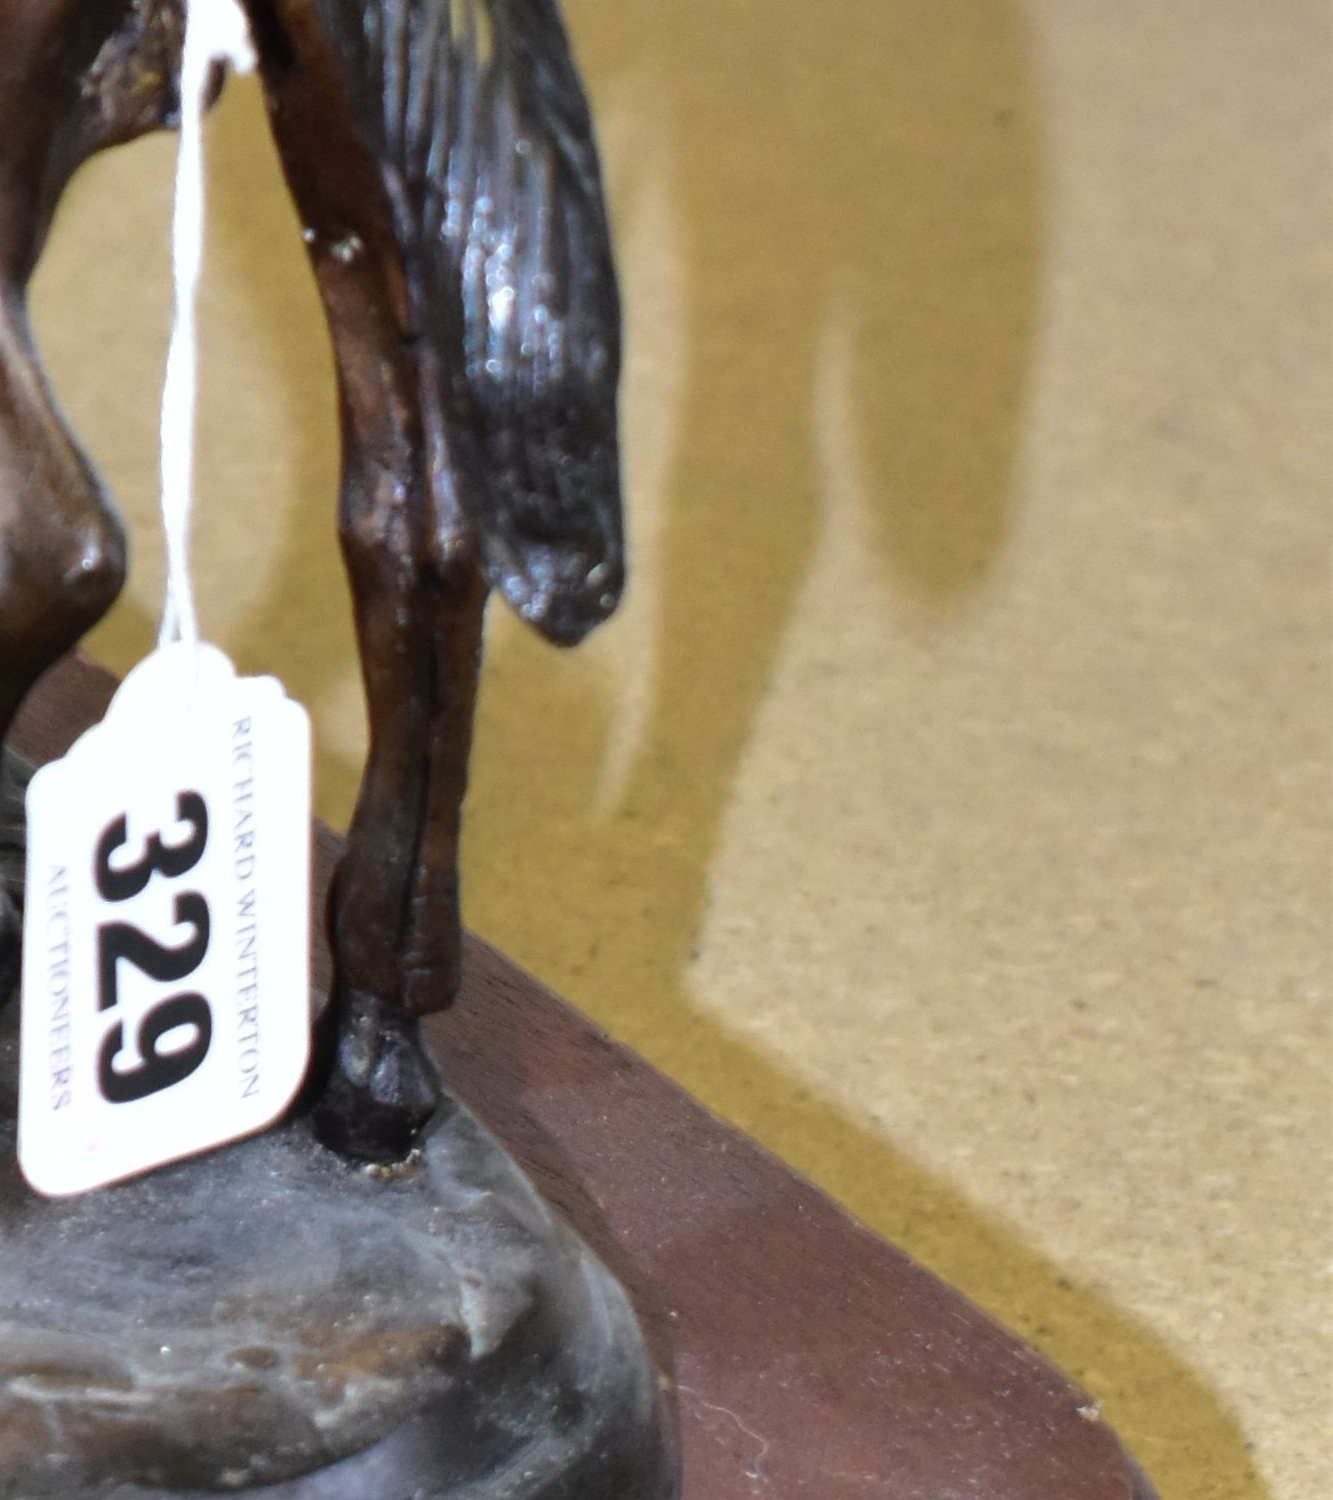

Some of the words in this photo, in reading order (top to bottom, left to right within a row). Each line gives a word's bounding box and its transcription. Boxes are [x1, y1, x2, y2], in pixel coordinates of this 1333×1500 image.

[232, 715, 256, 884] RICHARD
[46, 864, 72, 1111] AUCTIONEERS
[93, 789, 213, 1104] 329
[235, 888, 260, 1100] WINTERTON
